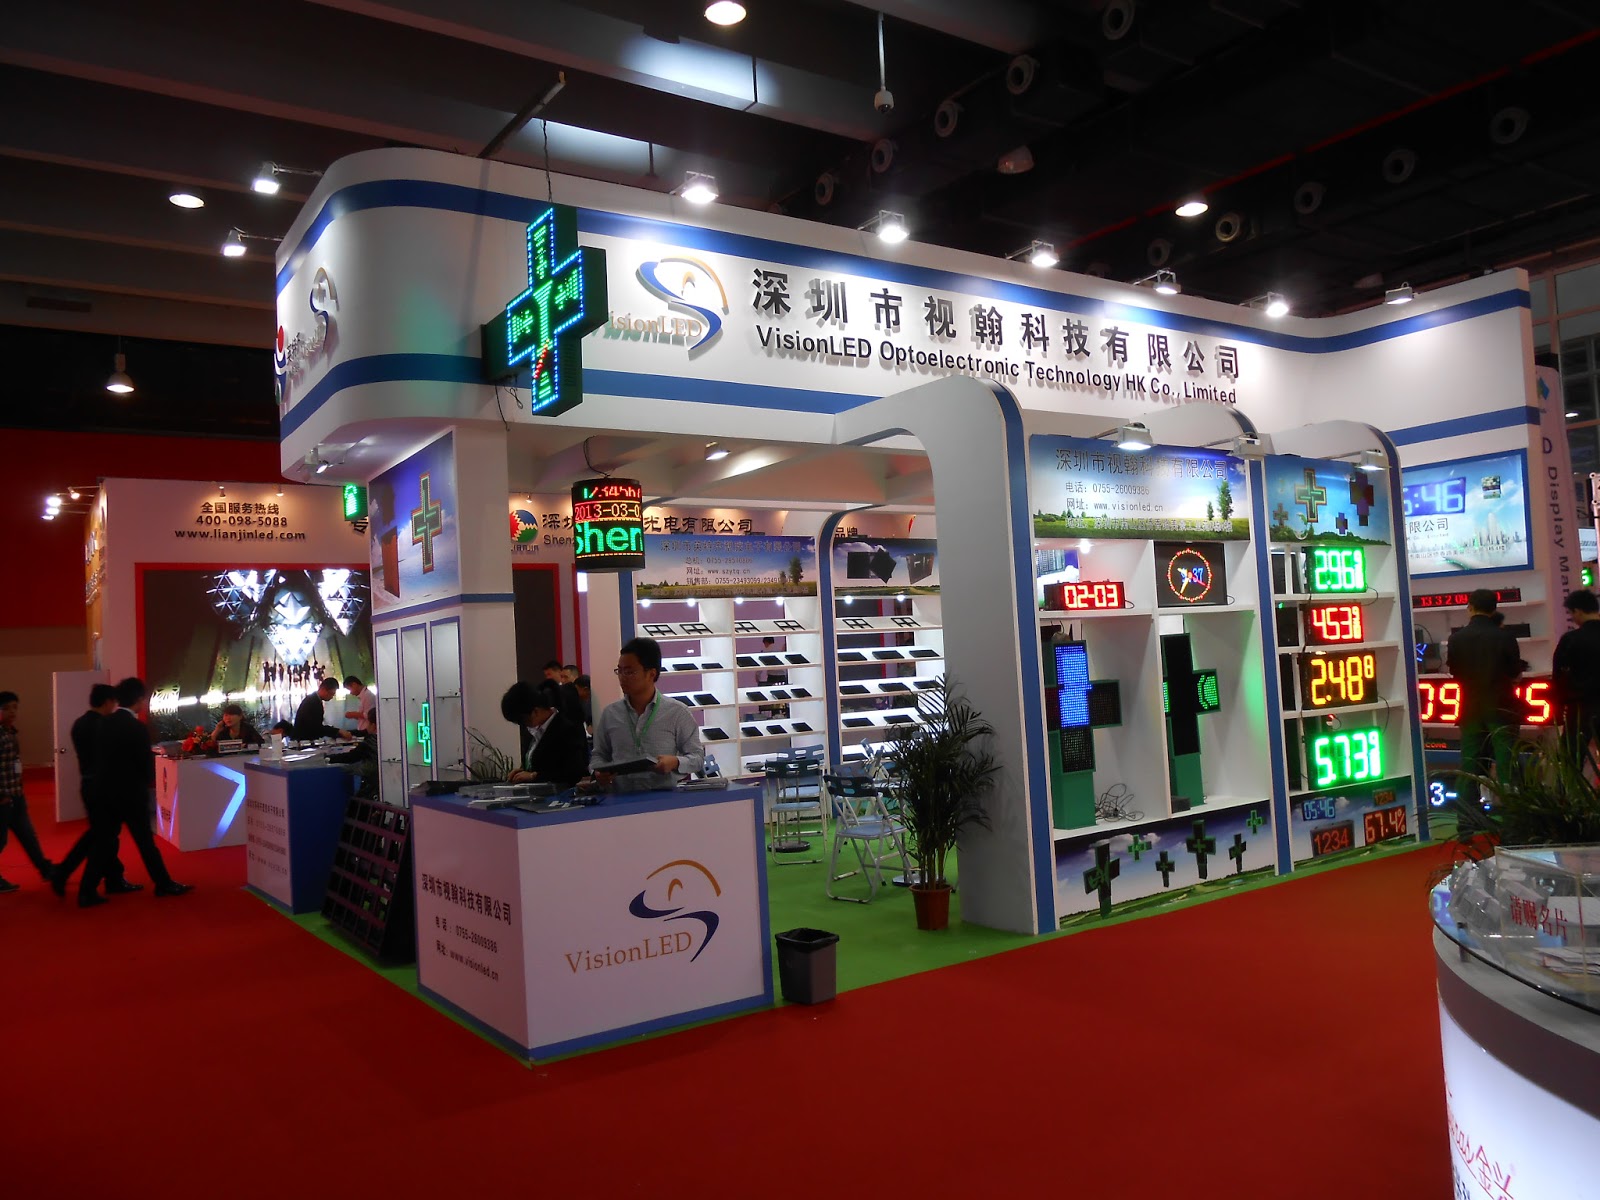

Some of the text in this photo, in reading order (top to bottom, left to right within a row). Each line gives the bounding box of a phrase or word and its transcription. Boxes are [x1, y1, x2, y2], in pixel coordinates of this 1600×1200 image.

[609, 311, 703, 338] isionLED
[753, 268, 1239, 379] 深圳市视翰科技有限公司
[756, 325, 1237, 404] VisionLED Optoelectronic Technology HK Co., Limited
[1055, 449, 1228, 481] 深圳市视翰科技有限公司
[201, 502, 280, 515] 全国服务热线
[1094, 501, 1164, 512] www.visionled.cn
[1547, 466, 1565, 549] Display
[196, 515, 288, 527] 400-098-5088
[174, 529, 306, 541] www.lianjinled.com
[543, 534, 574, 546] Shen
[1064, 584, 1119, 608] 02-03
[1303, 798, 1335, 820] 05:46
[1365, 808, 1406, 843] 67.4%
[1314, 828, 1349, 855] 1234
[565, 931, 692, 974] VisionLED
